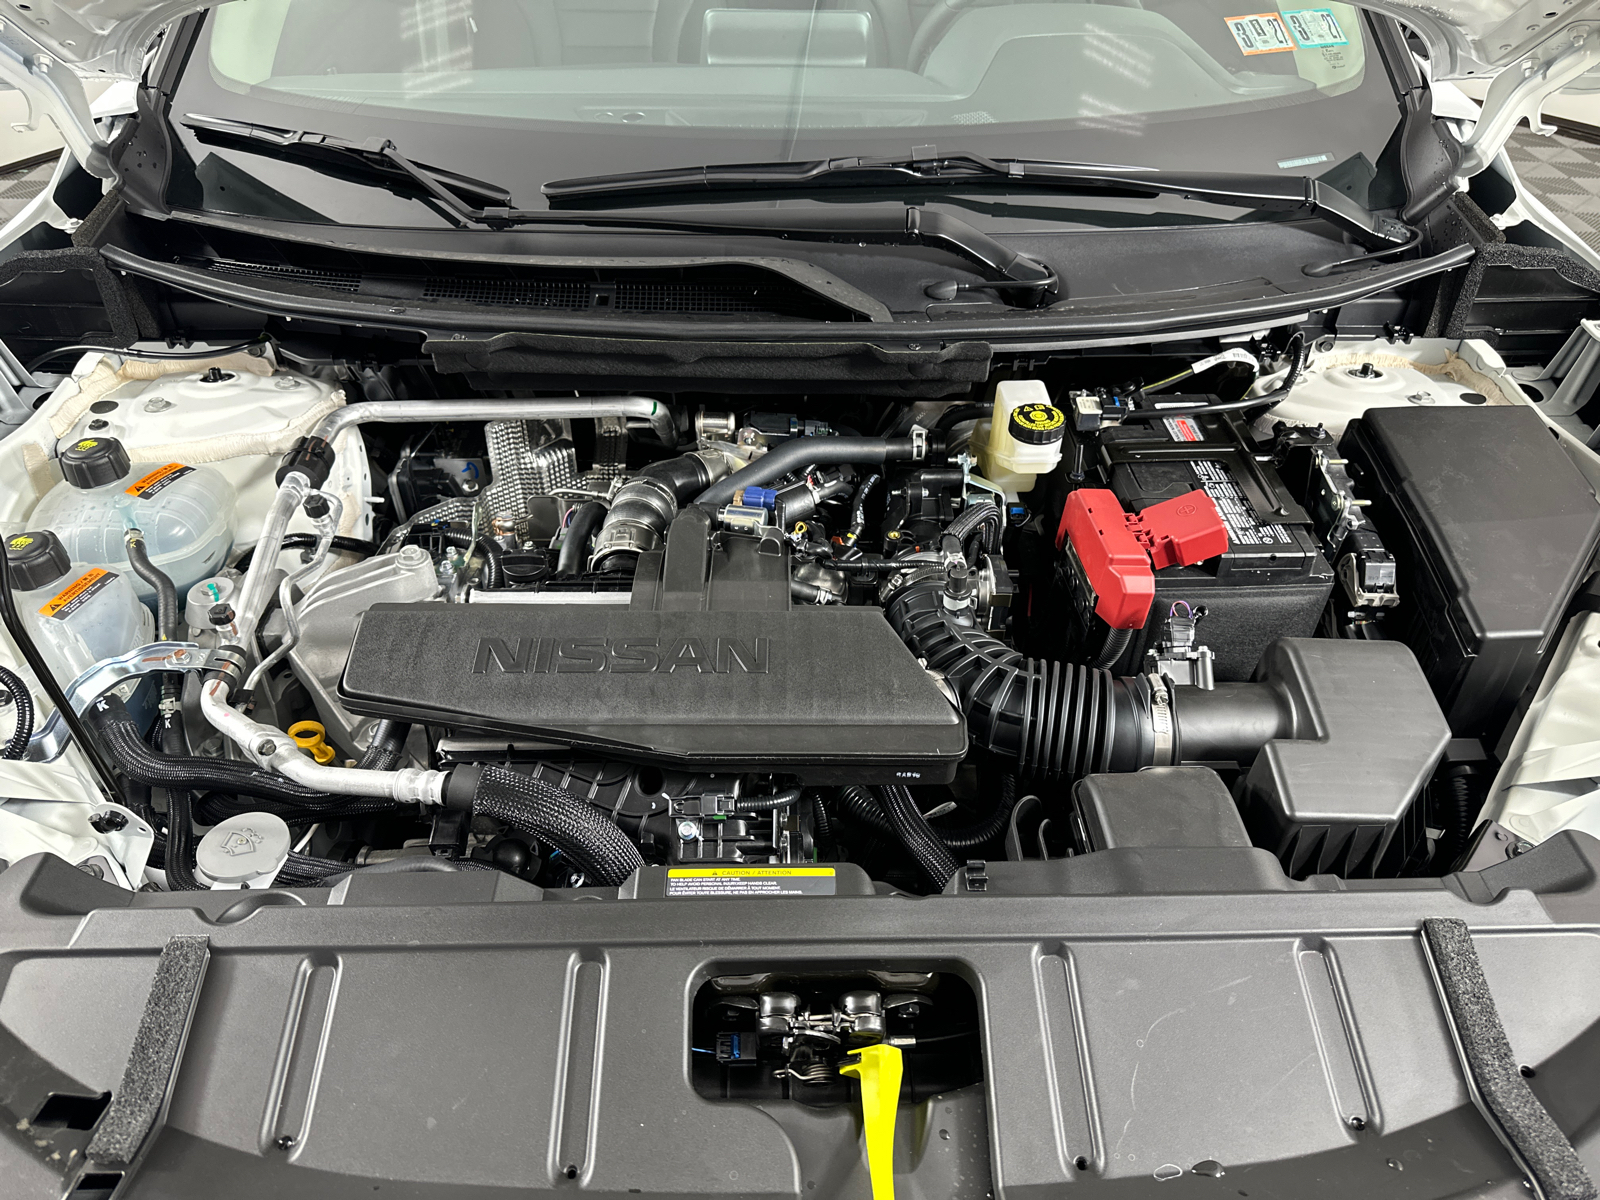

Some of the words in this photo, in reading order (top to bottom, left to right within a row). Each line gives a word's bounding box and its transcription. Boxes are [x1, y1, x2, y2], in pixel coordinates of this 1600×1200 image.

[1234, 22, 1254, 48] 3
[1267, 18, 1288, 44] 27
[1290, 15, 1310, 41] 3
[1320, 14, 1342, 39] 27
[472, 637, 770, 674] NISSAN
[96, 700, 110, 712] K
[164, 719, 172, 728] K
